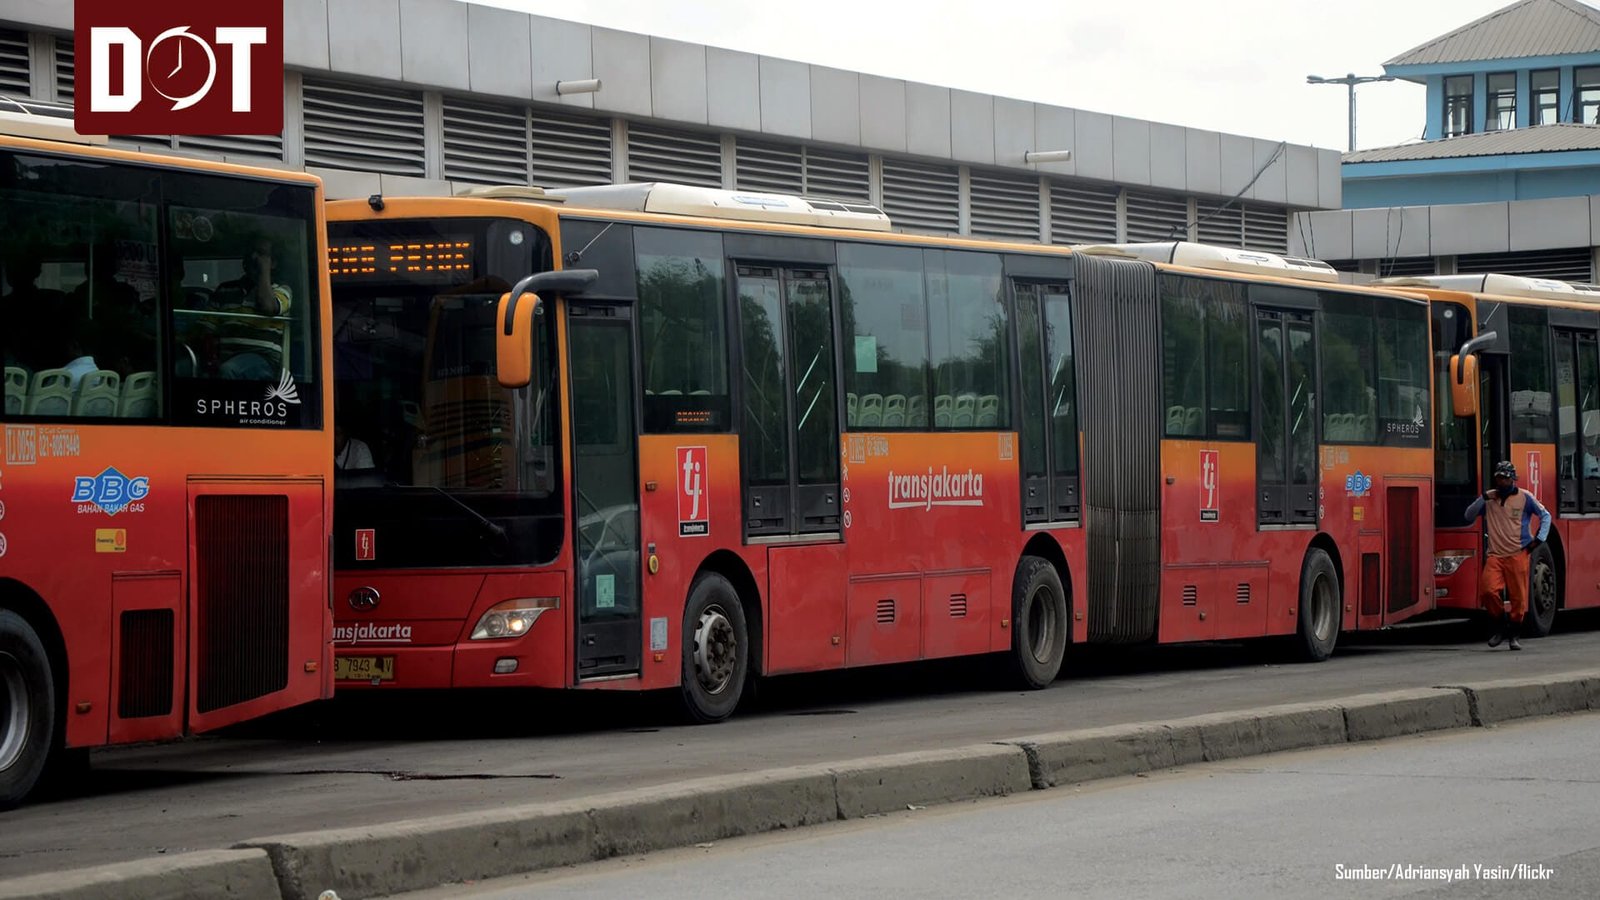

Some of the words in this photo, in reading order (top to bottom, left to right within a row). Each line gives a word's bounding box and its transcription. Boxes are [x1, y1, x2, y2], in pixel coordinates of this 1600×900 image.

[197, 399, 287, 417] SPHEROS
[1386, 423, 1420, 434] SPHEROS
[71, 476, 150, 502] BBG
[888, 465, 984, 512] transjakarta
[77, 504, 102, 514] BAHAN
[104, 503, 128, 513] BAKAR
[130, 503, 145, 513] GAS
[347, 659, 370, 672] 7943
